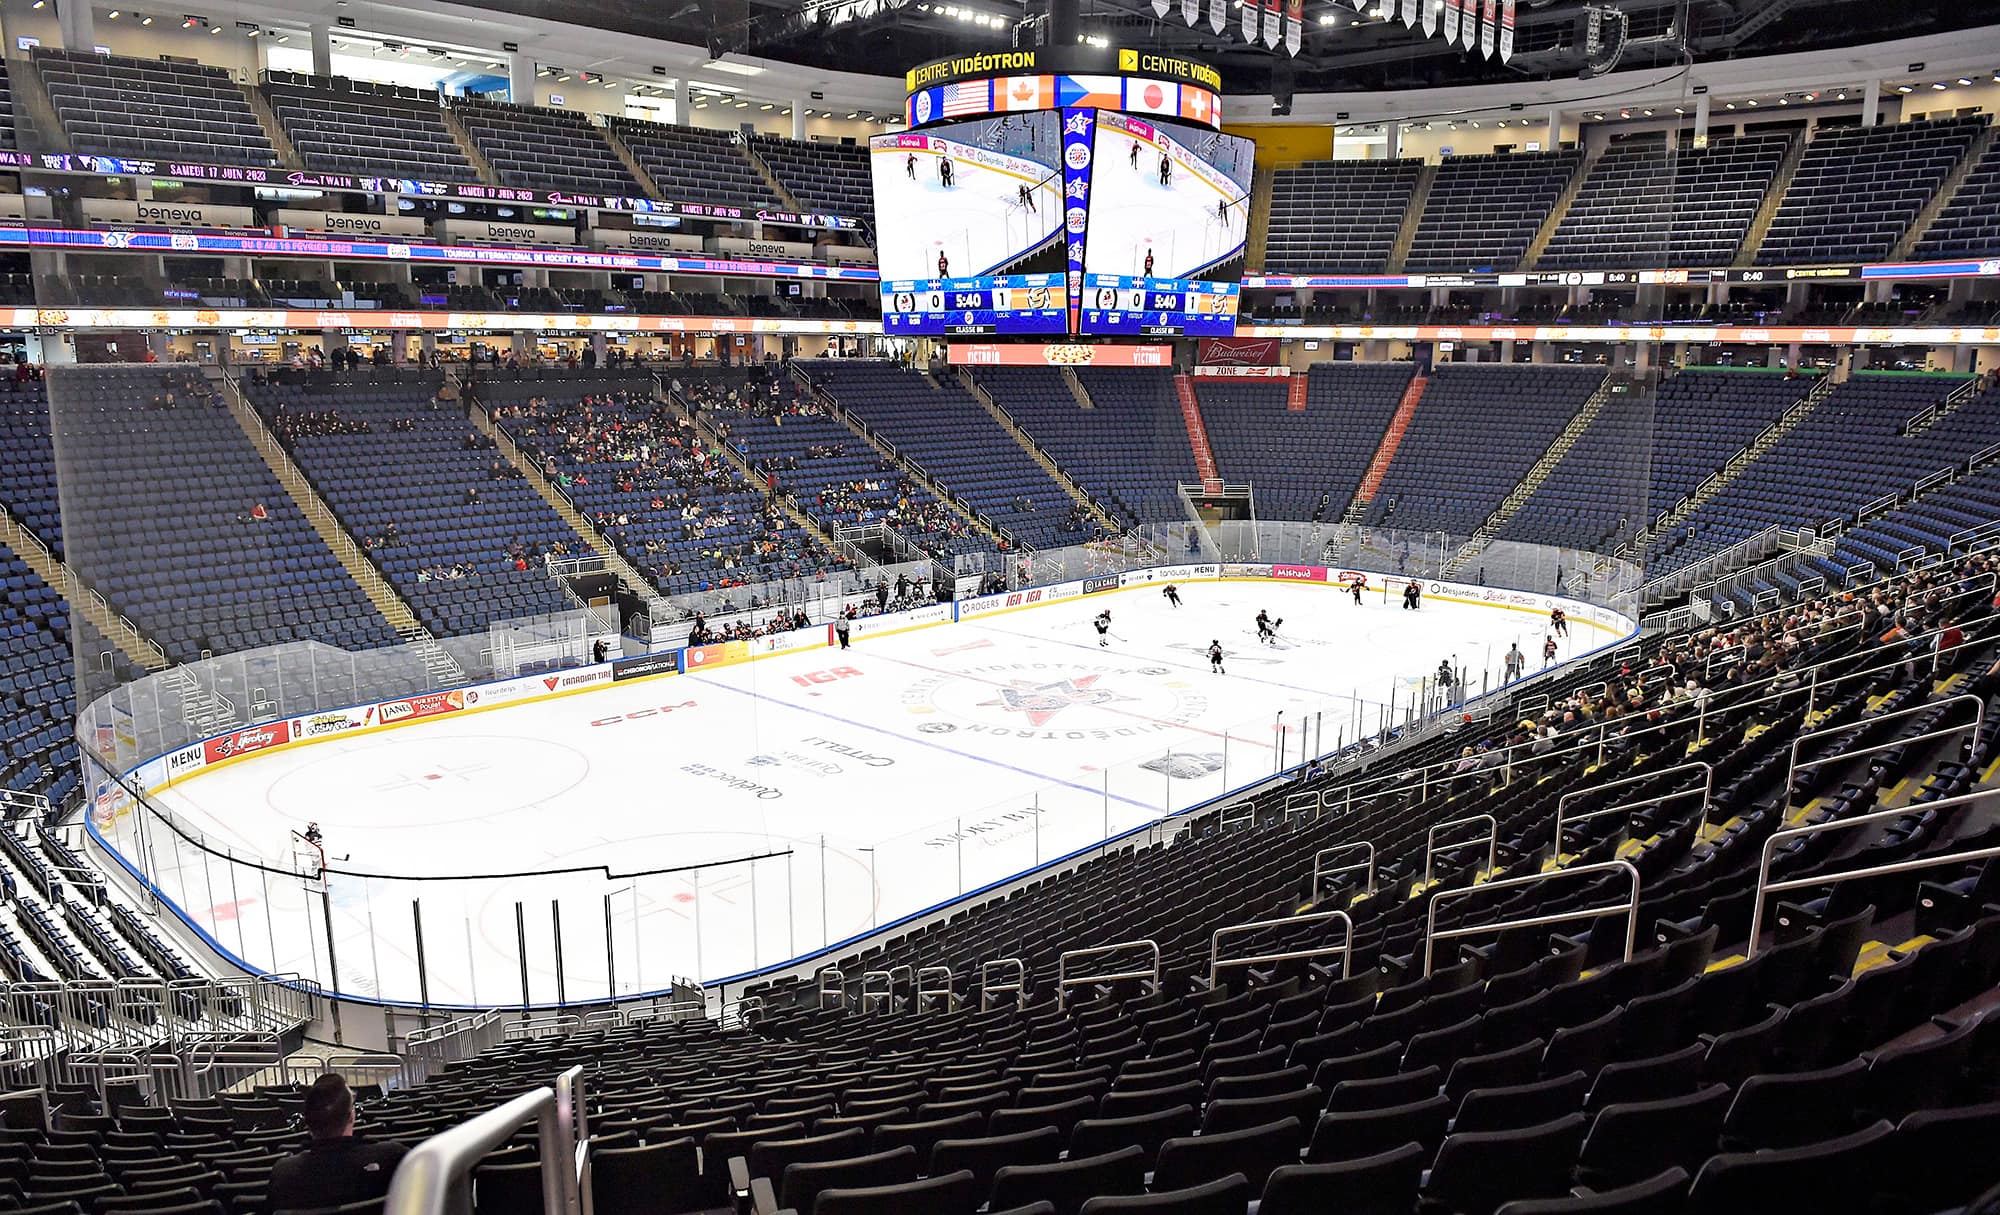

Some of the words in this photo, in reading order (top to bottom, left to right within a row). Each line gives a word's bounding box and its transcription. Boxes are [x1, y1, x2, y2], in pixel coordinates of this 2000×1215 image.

[916, 61, 949, 85] CENTRE
[951, 51, 1036, 75] VIDÉOTRON
[1142, 54, 1189, 77] CENTRE
[1190, 63, 1222, 93] VIDÉO
[169, 163, 206, 177] SAMEDI
[208, 167, 218, 178] 17
[221, 167, 243, 181] JUIN
[246, 170, 267, 182] 2023
[320, 175, 352, 188] TWAIN
[487, 188, 495, 199] 17
[497, 188, 515, 200] JUIN
[573, 195, 599, 206] TWAIN
[137, 202, 203, 221] beneva
[325, 214, 381, 230] beneva
[488, 224, 536, 239] beneva
[629, 233, 671, 247] beneva
[748, 241, 785, 254] beneva
[1743, 271, 1764, 282] 9:40
[932, 294, 940, 308] 0
[955, 293, 982, 308] 5:40
[999, 292, 1005, 306] 1
[1133, 293, 1141, 307] 0
[1154, 294, 1177, 309] 5:40
[1190, 296, 1195, 309] 1
[1209, 346, 1264, 359] Budweiser
[1215, 366, 1239, 375] ZONE
[1194, 565, 1216, 574] MENU
[1277, 568, 1312, 579] Michaud
[1095, 580, 1104, 589] LA
[1104, 576, 1118, 587] CAGE
[1005, 592, 1023, 607] IGA
[1025, 589, 1042, 603] IGA
[1442, 586, 1480, 599] Desjardins
[970, 599, 1000, 612] ROGERS
[562, 672, 597, 687] CANADIAN
[597, 670, 612, 681] TIRE
[789, 666, 865, 688] IGA
[384, 703, 413, 718] JANES
[590, 700, 698, 727] CCM
[170, 747, 202, 768] MENU
